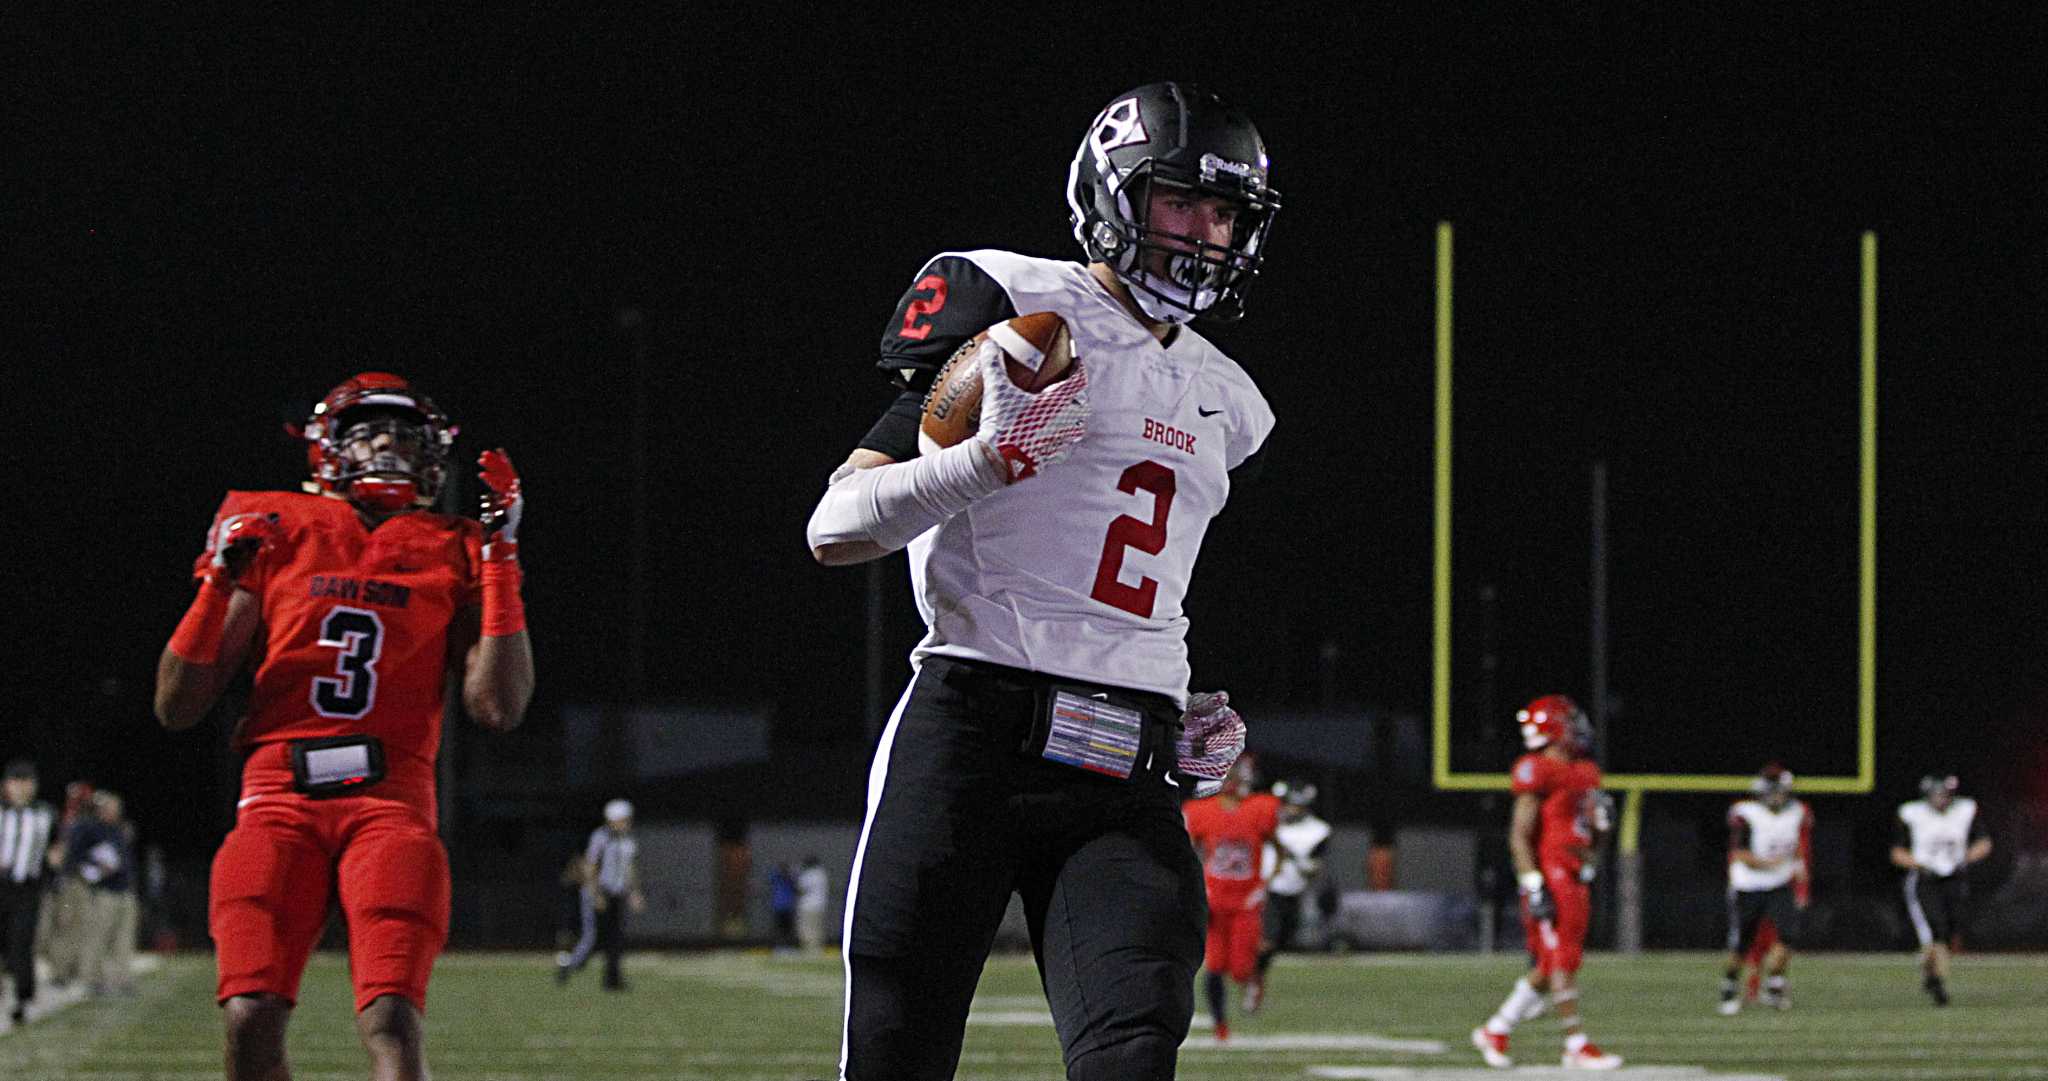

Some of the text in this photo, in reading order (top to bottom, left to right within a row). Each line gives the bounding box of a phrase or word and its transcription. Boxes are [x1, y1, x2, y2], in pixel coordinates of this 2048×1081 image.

[899, 274, 948, 341] 2
[1142, 418, 1197, 455] BROOK
[1091, 460, 1177, 619] 2
[310, 605, 384, 720] 3
